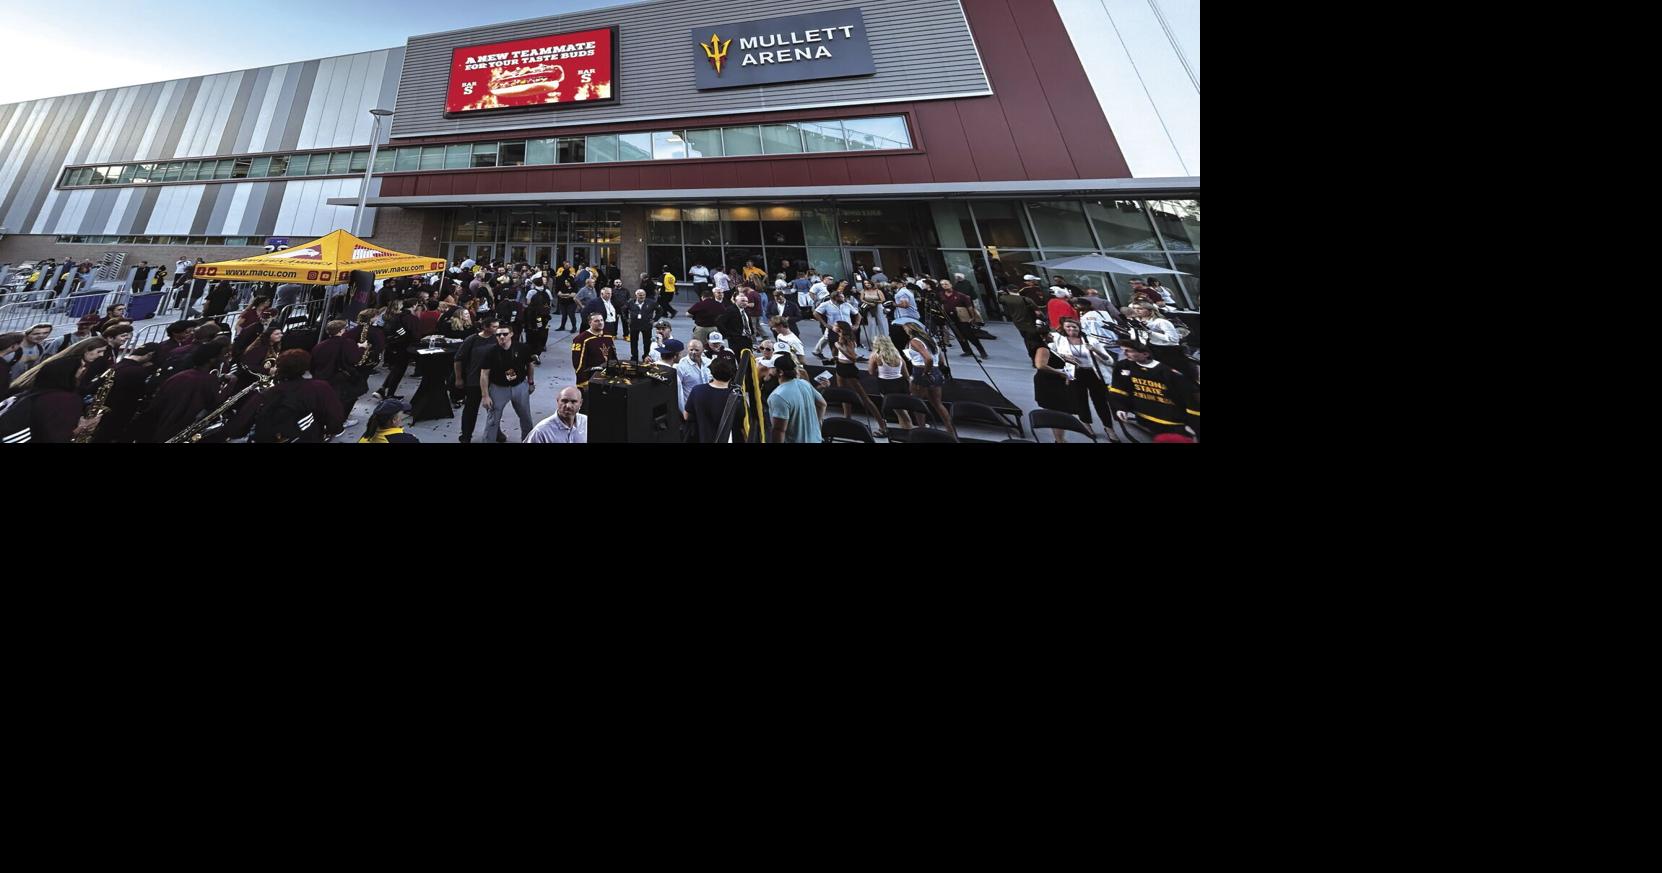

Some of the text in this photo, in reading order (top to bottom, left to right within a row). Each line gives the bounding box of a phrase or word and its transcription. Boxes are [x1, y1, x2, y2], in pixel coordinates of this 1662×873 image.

[739, 25, 854, 50] MULLETT
[465, 41, 596, 64] A NEW TEAMMATE
[465, 49, 595, 71] FOR YOUR TASTE BUDS
[741, 46, 832, 66] ARENA
[581, 73, 592, 83] S
[464, 86, 473, 95] S
[225, 269, 297, 278] www.macu.com
